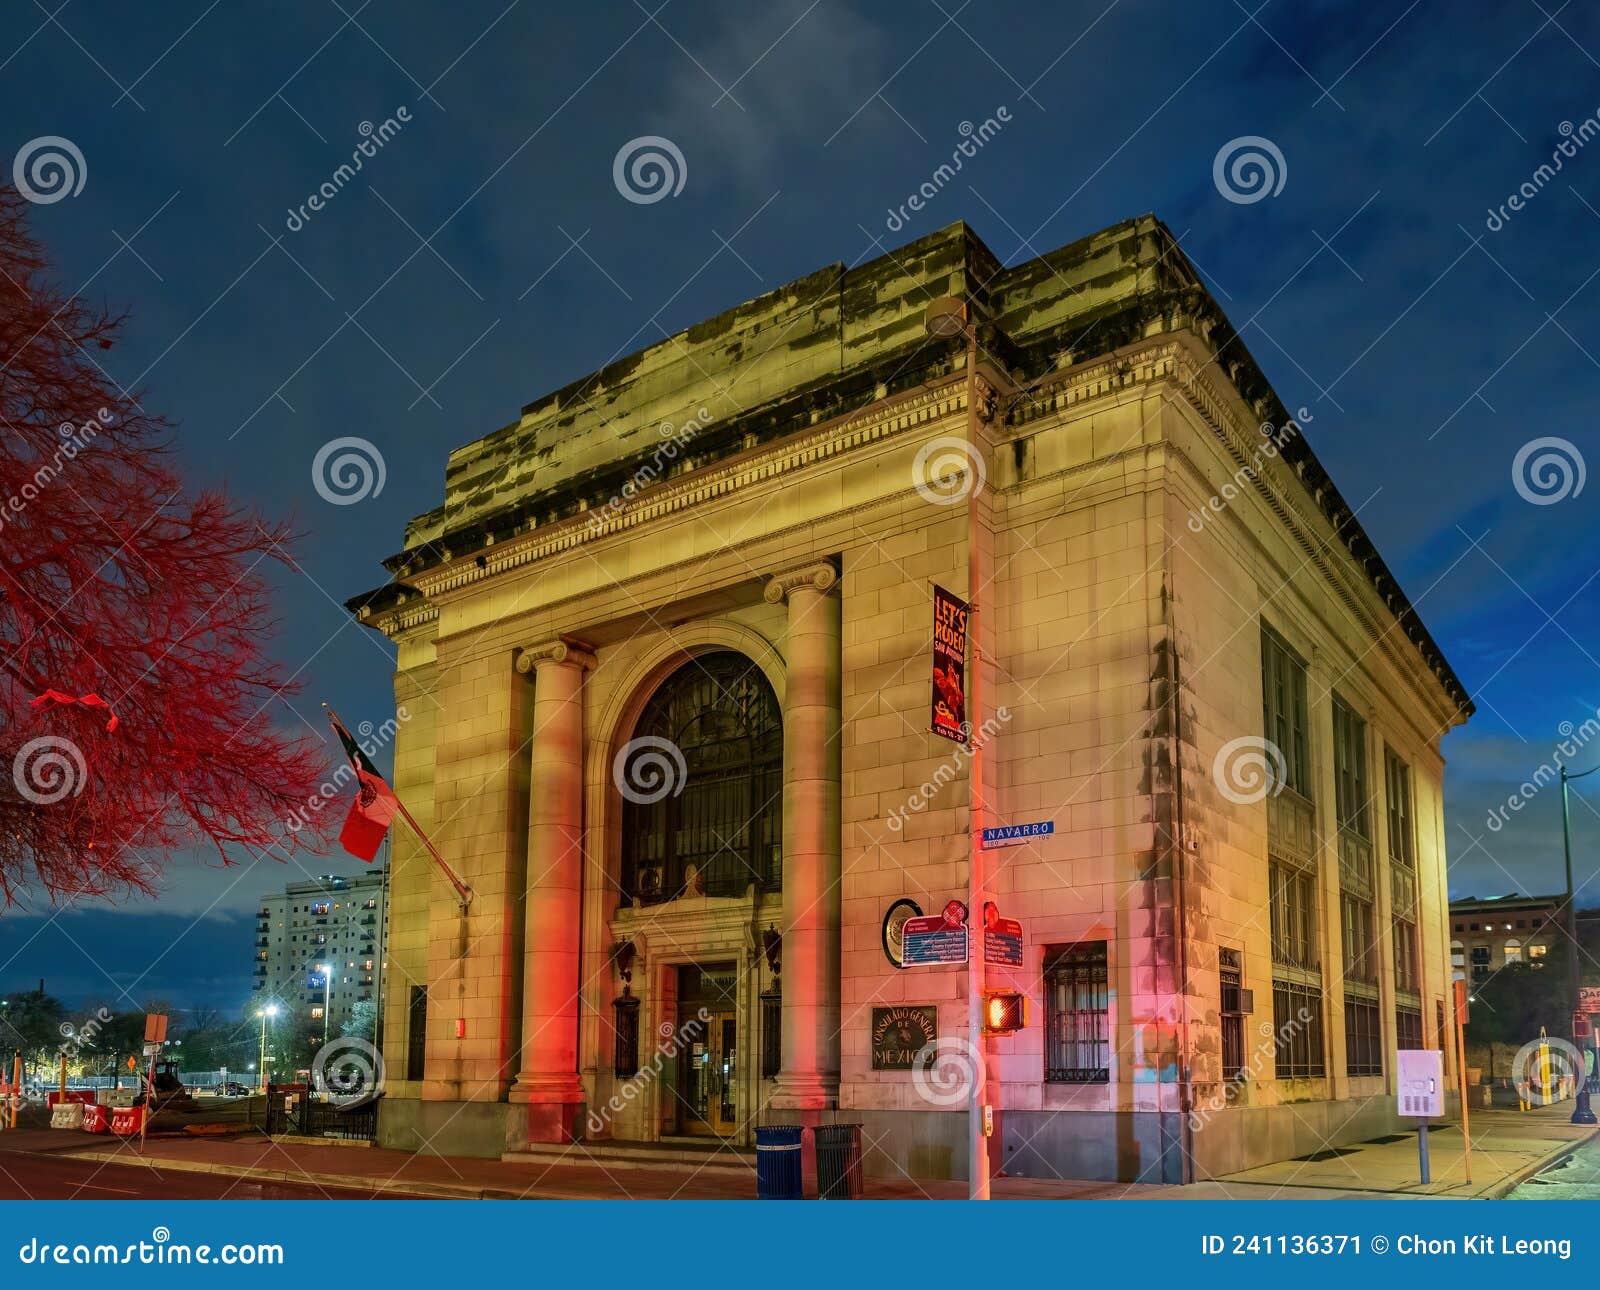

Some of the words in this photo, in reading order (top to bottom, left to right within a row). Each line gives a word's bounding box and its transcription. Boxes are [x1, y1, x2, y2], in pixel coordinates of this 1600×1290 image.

[936, 596, 966, 633] LET'S
[935, 620, 964, 653] RODEO
[988, 823, 1049, 840] NAVARRO
[874, 1048, 935, 1064] MEXICO
